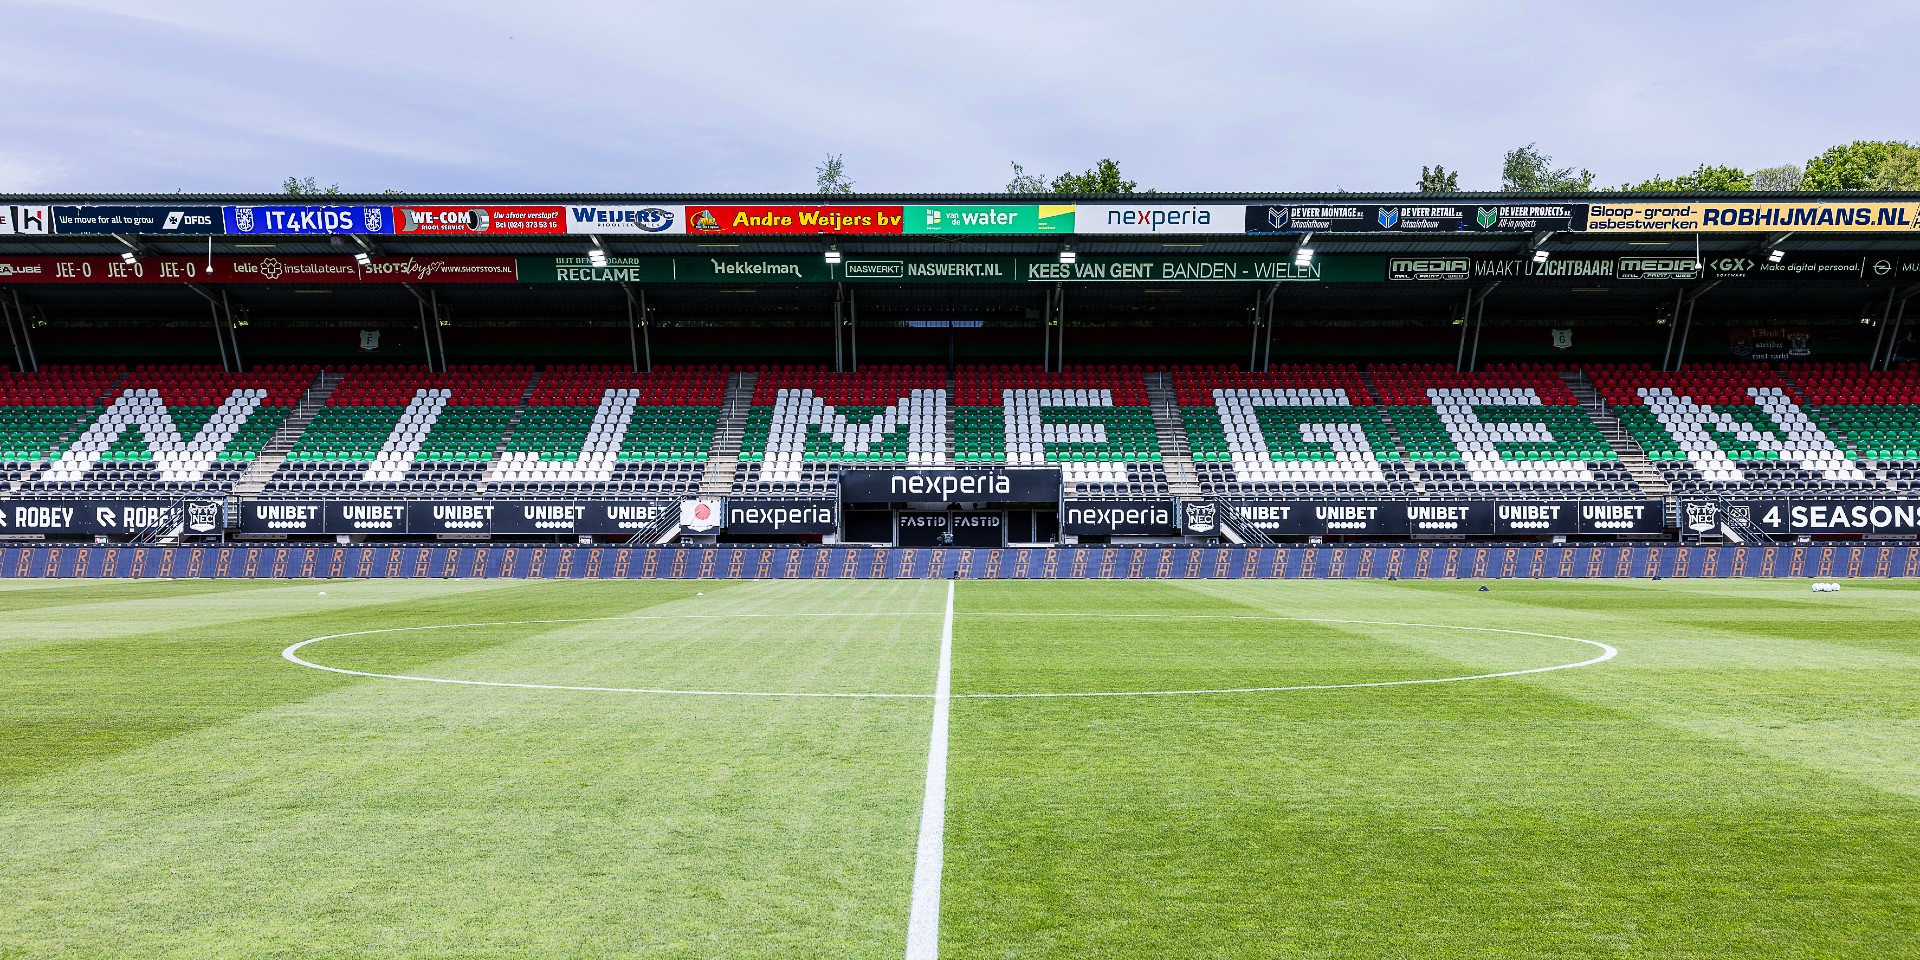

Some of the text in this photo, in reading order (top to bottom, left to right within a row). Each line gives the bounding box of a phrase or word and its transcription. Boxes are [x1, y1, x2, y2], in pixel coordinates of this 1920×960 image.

[411, 212, 472, 224] WE-COM
[572, 208, 662, 222] WEIJERS
[963, 209, 1018, 225] water
[1291, 208, 1300, 217] DE
[1301, 208, 1320, 217] VEER
[1321, 208, 1357, 217] MONTAGE
[1401, 207, 1411, 217] DE
[1412, 207, 1430, 217] VEER
[1430, 207, 1455, 217] RETAIL
[1500, 207, 1510, 216] DE
[1510, 207, 1528, 216] VEER
[1529, 207, 1564, 216] PROJECTS
[1703, 208, 1910, 225] ROBHIJMANS.NL
[60, 216, 73, 224] We
[98, 216, 110, 224] for
[112, 216, 122, 224] all
[124, 216, 132, 224] to
[134, 217, 154, 226] grow
[185, 216, 212, 225] DFDS
[265, 211, 353, 231] IT4KIDS
[733, 211, 793, 227] Andre
[799, 211, 872, 231] Weijers
[877, 212, 902, 226] bv
[1107, 206, 1211, 231] nexperia
[1498, 219, 1537, 229] All-in projects
[1589, 220, 1698, 229] asbestwerken
[0, 264, 41, 275] ALUBE
[56, 262, 92, 277] JEE-O
[108, 262, 144, 277] JEE-O
[160, 262, 196, 277] JEE-O
[233, 262, 258, 273] lelie
[713, 260, 801, 276] Hekkelman
[850, 265, 900, 273] NASWERKT
[908, 263, 1003, 275] NASWERKT.NL
[1029, 263, 1071, 278] KEES
[1074, 263, 1106, 278] VAN
[1110, 263, 1154, 278] GENT
[1162, 263, 1237, 278] BANDEN
[1254, 263, 1321, 278] WIELEN
[1392, 261, 1467, 271] MEDIA
[1475, 260, 1613, 275] MAAKT U ZICHTBAAR!
[1620, 260, 1696, 271] MEDIA
[1760, 262, 1860, 274] Make digital personal.
[557, 268, 640, 281] RECLAME
[367, 337, 374, 345] F
[1559, 335, 1566, 343] G
[891, 471, 1010, 501] nexperia
[15, 507, 74, 527] ROBEY
[192, 515, 213, 523] NEC
[257, 506, 318, 519] UNIBET
[343, 506, 404, 519] UNIBET
[433, 506, 494, 519] UNIBET
[524, 506, 585, 519] UNIBET
[731, 505, 831, 529] nexperia
[1068, 505, 1168, 530] nexperia
[1316, 507, 1377, 519] UNIBET
[1407, 507, 1469, 519] UNIBET
[1499, 506, 1560, 519] UNIBET
[1583, 506, 1644, 519] UNIBET
[1692, 515, 1713, 523] NEC
[1763, 506, 1781, 527] 4
[1791, 505, 1920, 527] SEASON
